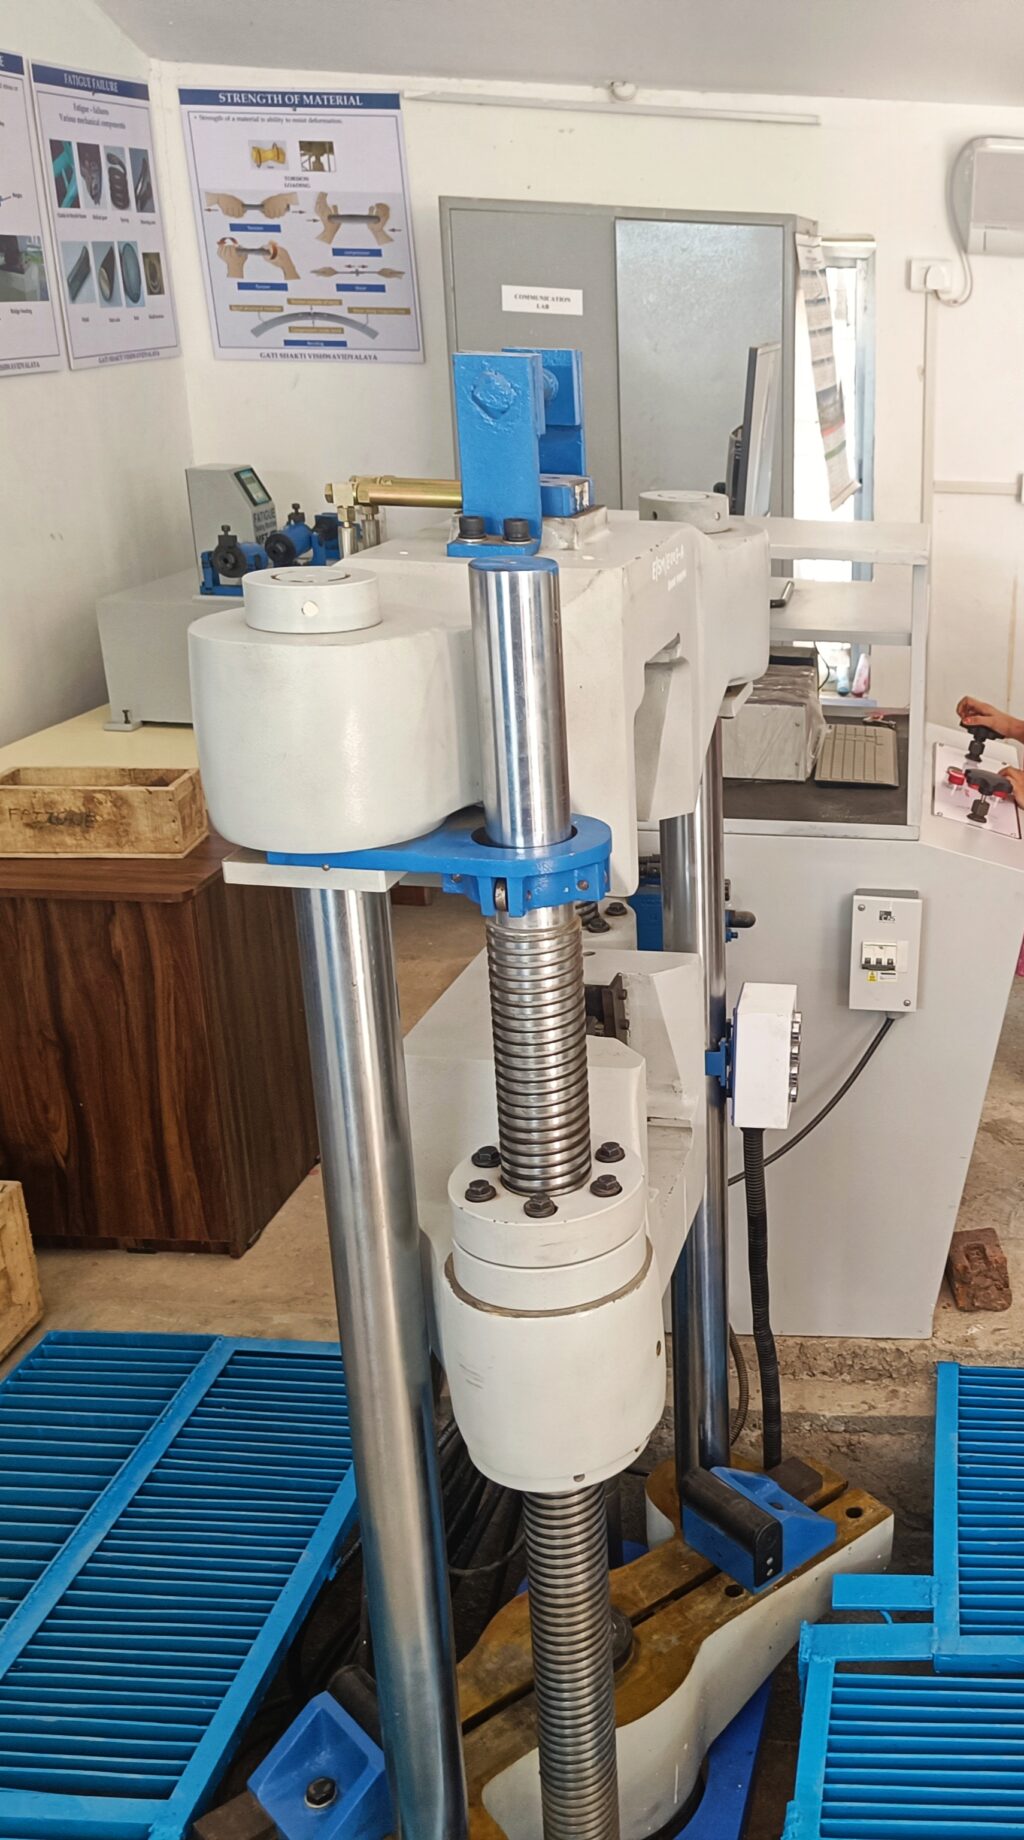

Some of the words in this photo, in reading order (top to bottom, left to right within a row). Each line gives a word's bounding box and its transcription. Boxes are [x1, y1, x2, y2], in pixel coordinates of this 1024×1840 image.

[63, 73, 91, 89] FATIGUE
[91, 78, 119, 93] FAILURE
[218, 92, 282, 105] STRENGTH
[284, 94, 300, 105] OF
[303, 95, 363, 106] MATERIAL
[253, 507, 276, 523] FATIGUE
